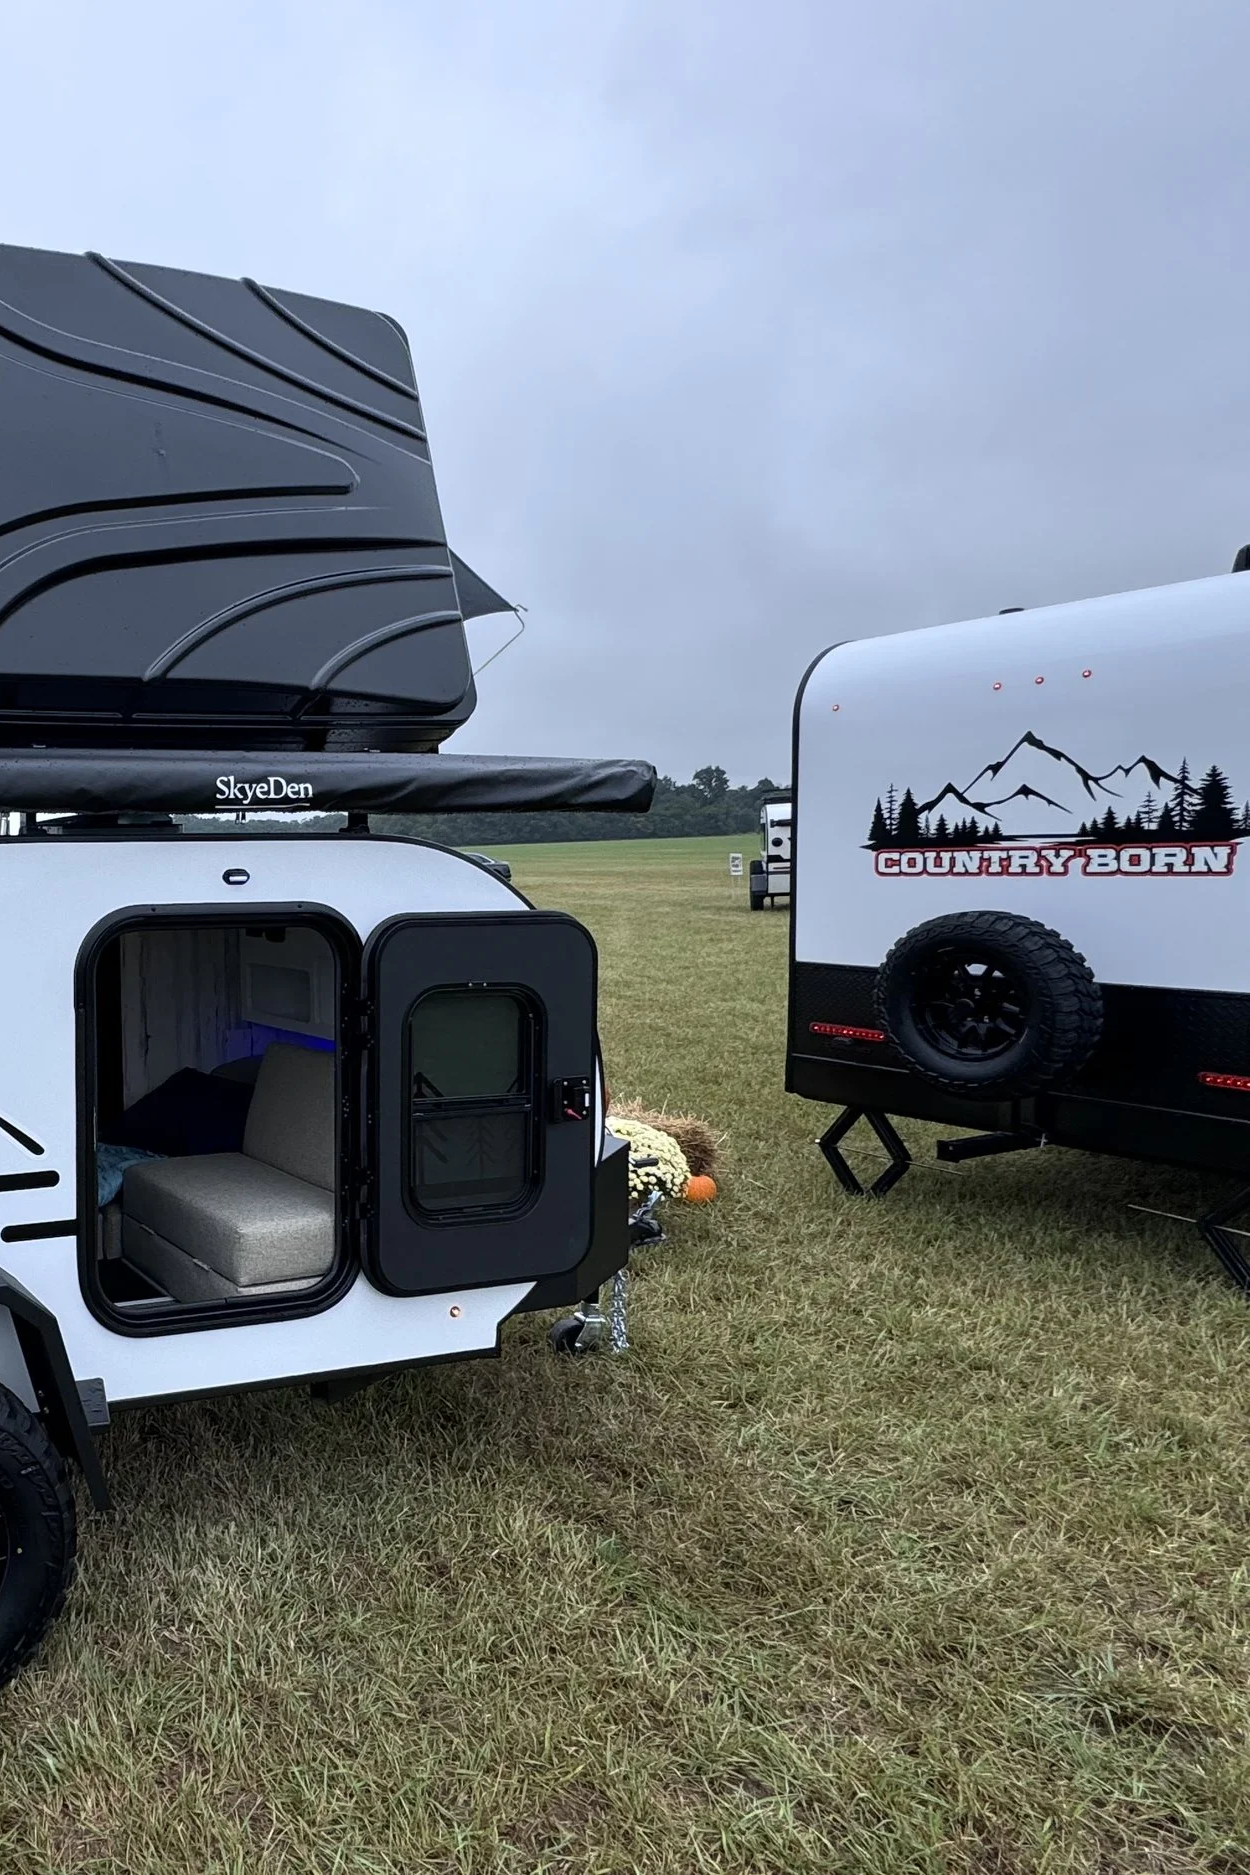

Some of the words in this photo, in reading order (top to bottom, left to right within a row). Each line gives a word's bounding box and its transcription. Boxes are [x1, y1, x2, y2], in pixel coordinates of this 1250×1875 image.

[215, 775, 314, 804] SkyeDen
[876, 848, 1075, 875] COUNTRY
[1085, 845, 1232, 873] BORN
